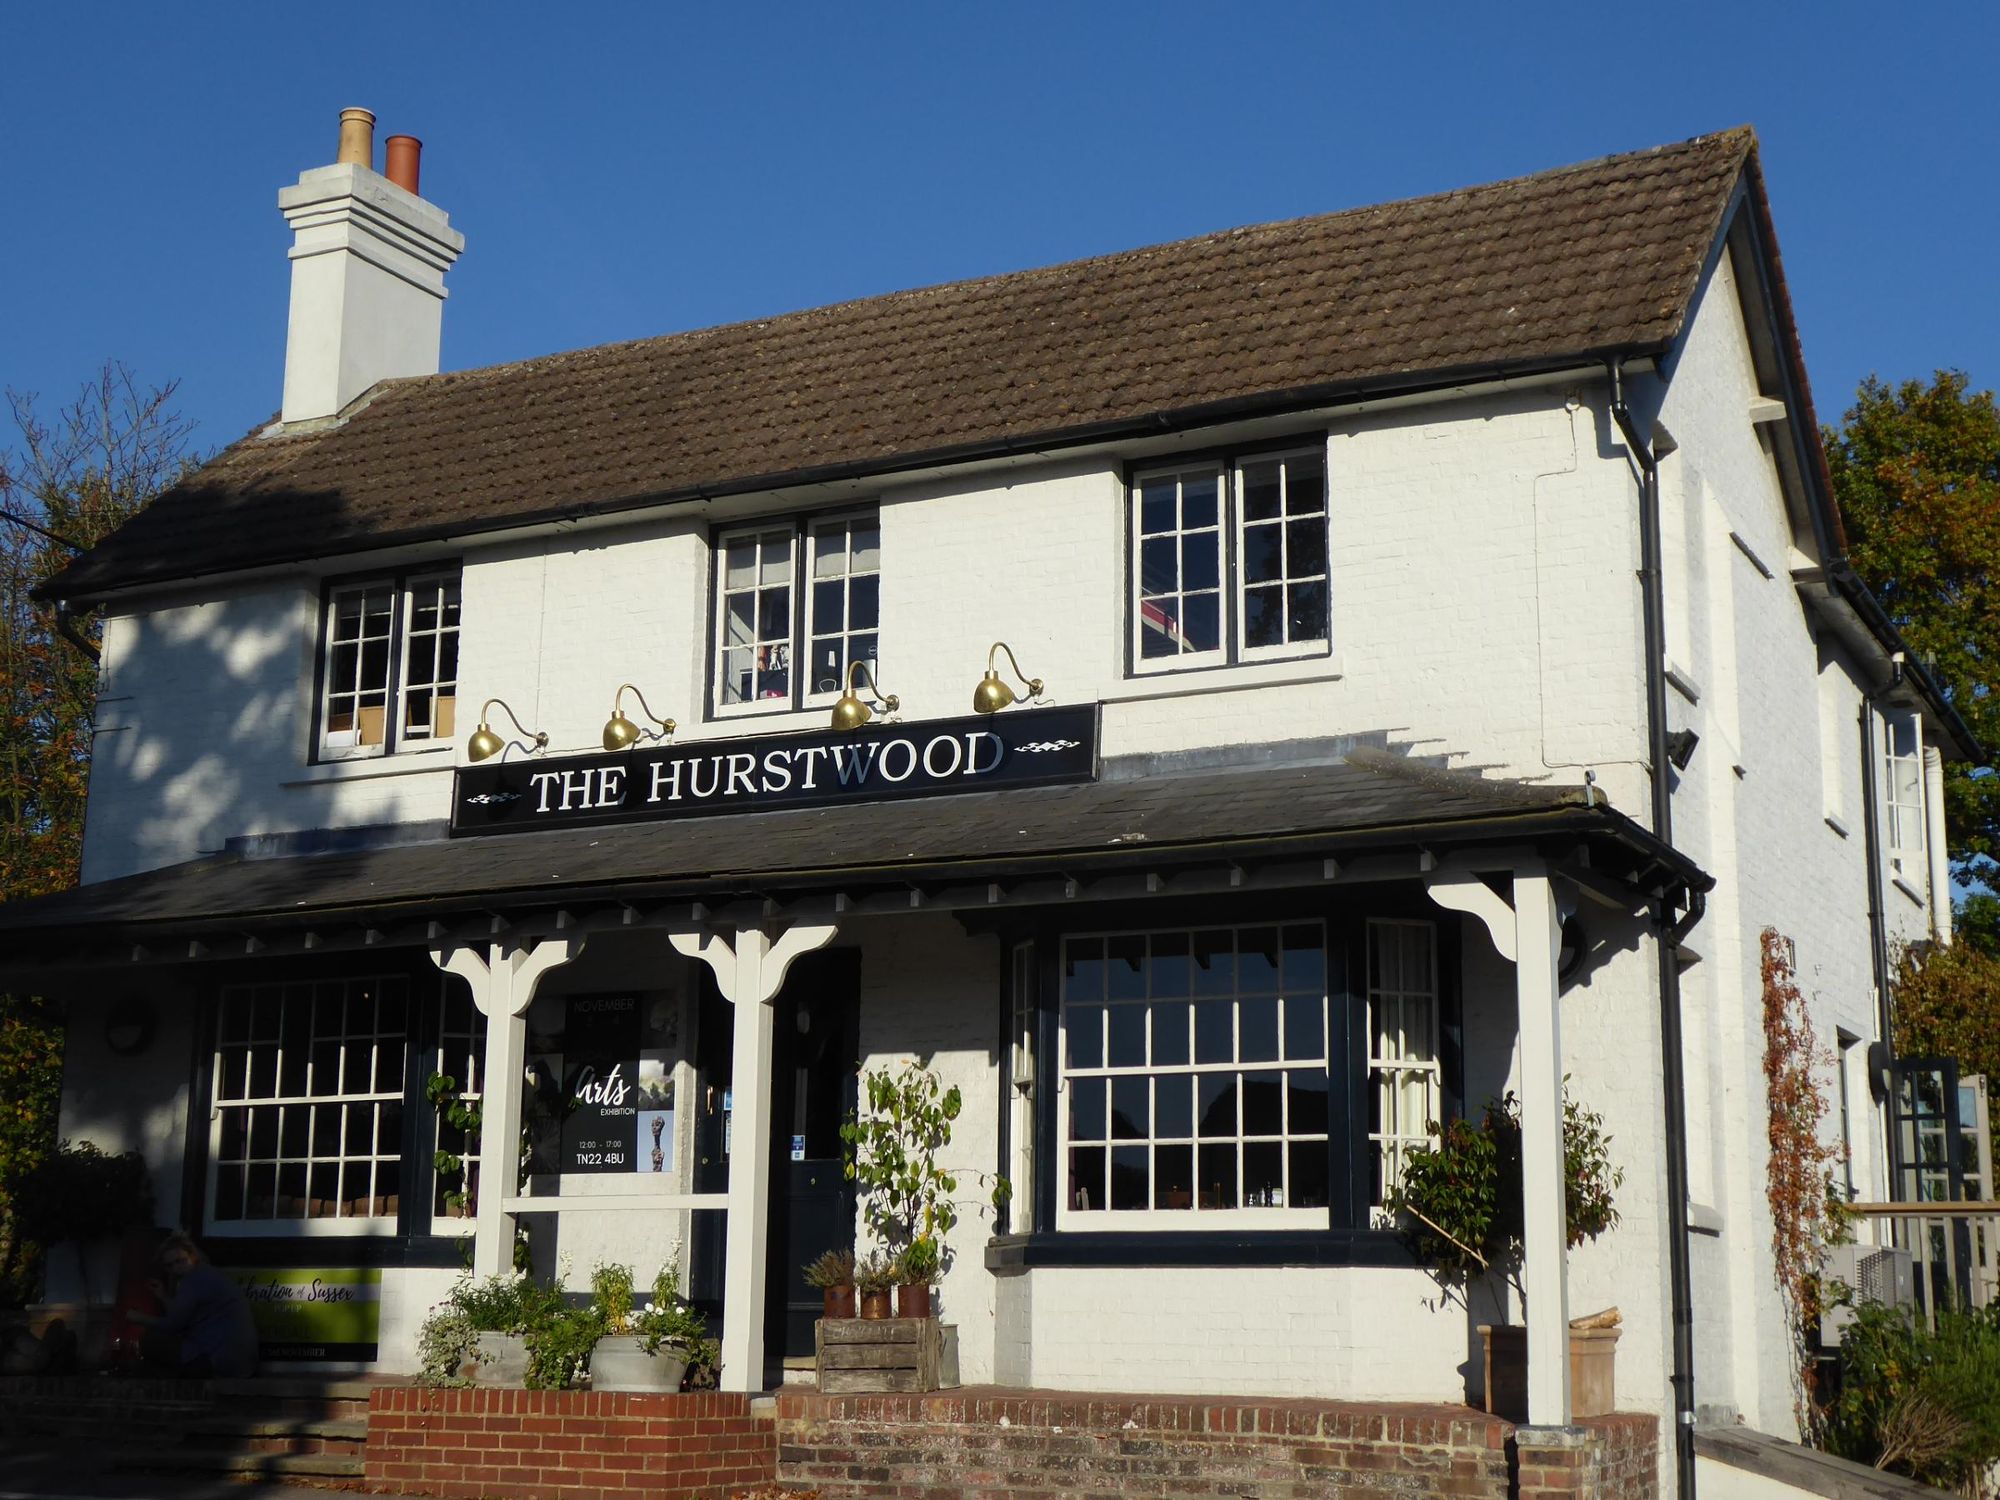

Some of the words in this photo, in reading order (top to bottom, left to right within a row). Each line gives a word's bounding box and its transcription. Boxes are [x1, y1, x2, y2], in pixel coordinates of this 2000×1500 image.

[529, 766, 627, 813] THE
[647, 731, 1005, 804] HURSTWOOD
[574, 998, 635, 1013] NOVEMBER
[575, 1065, 631, 1106] Arts
[600, 1107, 636, 1116] EXHIBITION
[579, 1141, 597, 1149] 12:00
[606, 1140, 622, 1148] 17:00
[576, 1153, 602, 1165] TN22
[604, 1152, 625, 1164] 4BU
[244, 1275, 294, 1302] bration
[307, 1278, 354, 1303] Sussex
